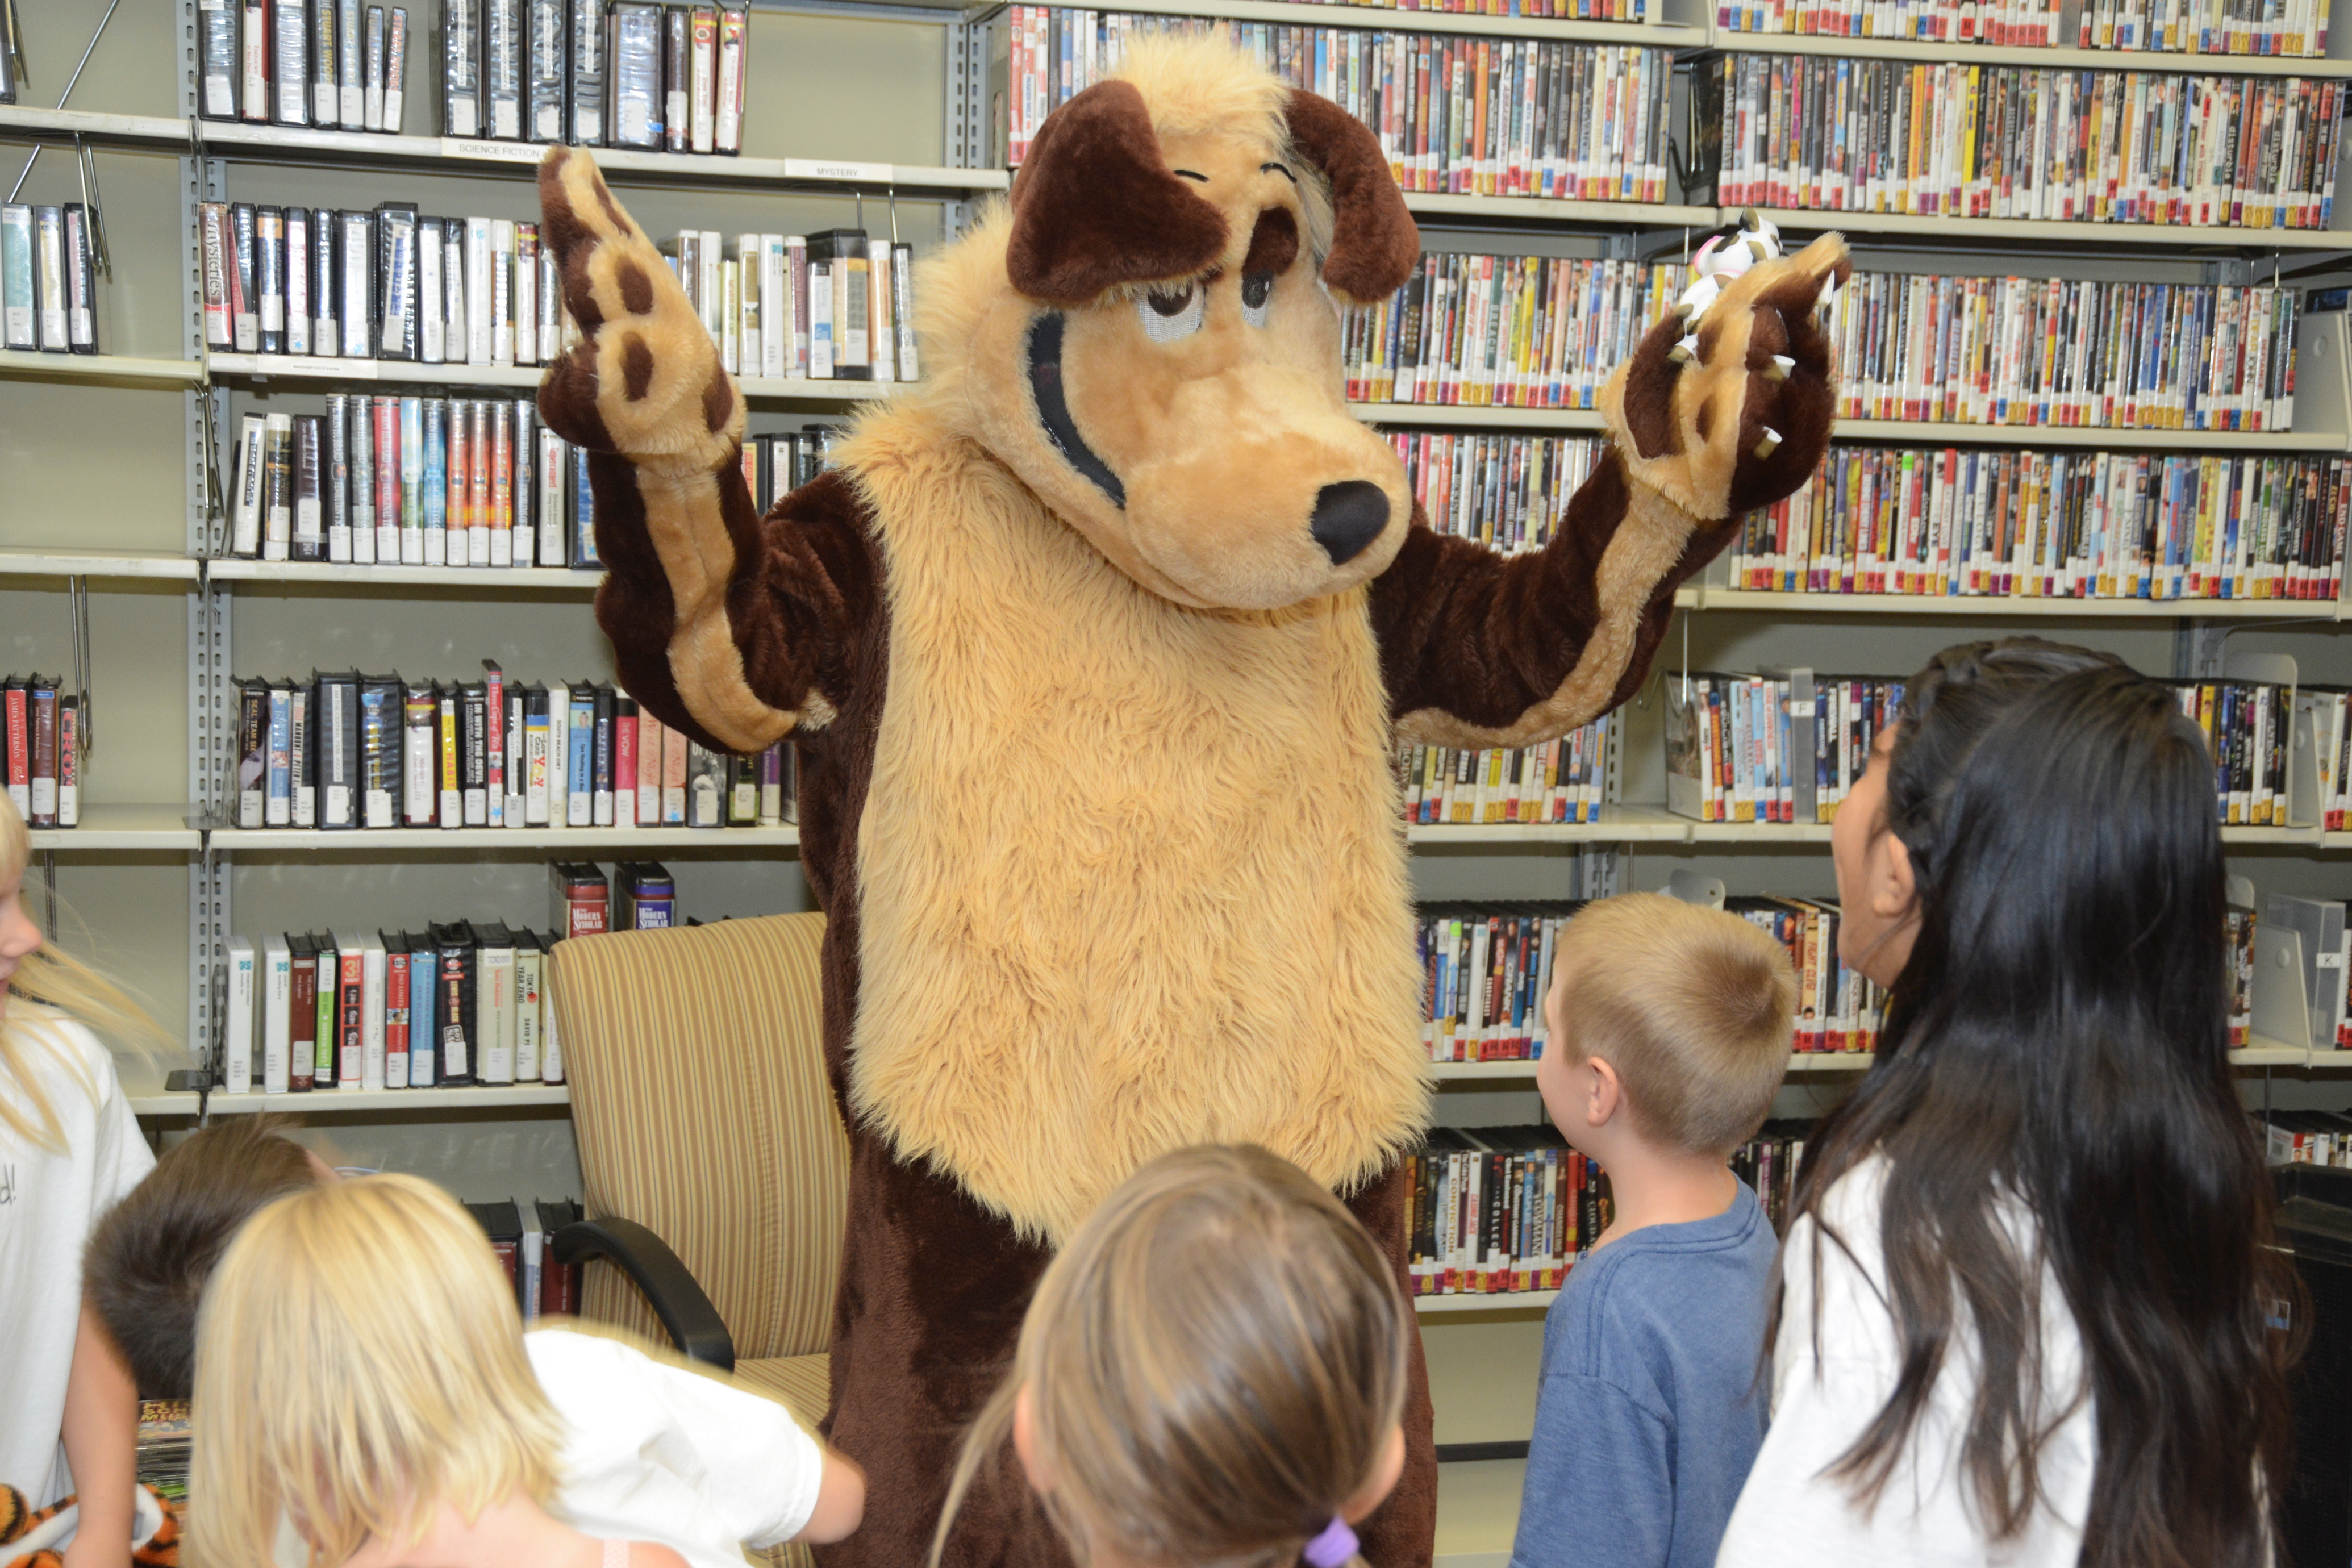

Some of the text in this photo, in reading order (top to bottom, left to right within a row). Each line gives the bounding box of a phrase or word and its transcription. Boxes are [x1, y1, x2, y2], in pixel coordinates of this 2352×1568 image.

[321, 9, 334, 85] STUART WOODS
[345, 10, 356, 84] STUART WOODS
[460, 144, 539, 157] SCIENCE FICTION
[2225, 126, 2237, 180] disturbia
[2270, 130, 2283, 184] disturbia
[816, 166, 858, 177] MYSTERY
[203, 223, 222, 296] mysteries
[1469, 291, 1477, 315] BRING
[1487, 304, 1499, 355] BREACH
[2249, 319, 2259, 352] DEAR
[2258, 339, 2268, 390] DEFIANCE
[382, 414, 393, 428] RON
[333, 427, 344, 461] HUBBARD
[382, 429, 393, 463] HUBBARD
[428, 418, 439, 465] RON HUBBARD
[519, 430, 529, 463] HUBBARD
[548, 447, 559, 488] Superconnect
[382, 487, 393, 515] ORIGINAL
[2337, 504, 2346, 527] END
[490, 706, 502, 725] Cups
[1799, 703, 1807, 714] F
[1828, 688, 1838, 743] FIREWALL
[10, 697, 23, 782] JAMES PATTERSON First
[474, 704, 483, 784] IN WITH THE DEVIL
[491, 733, 501, 749] Tea
[622, 735, 630, 757] VOW
[1766, 712, 1774, 749] DARKNESS
[293, 722, 302, 778] MANHUNT PETER
[446, 752, 456, 788] HABIT
[572, 908, 600, 920] MODERN
[573, 920, 603, 930] SCHOLAR
[639, 907, 667, 919] MODERN
[639, 919, 669, 929] SCHOLAR
[345, 960, 356, 977] 3
[1806, 941, 1818, 991] FIGHT CLUB
[2325, 955, 2333, 966] K
[398, 974, 404, 984] NO
[1503, 961, 1515, 1012] CRANK
[1503, 1174, 1512, 1210] Eastwood
[1449, 1178, 1458, 1253] CONVICTION
[1555, 1204, 1564, 1252] CHANGELING
